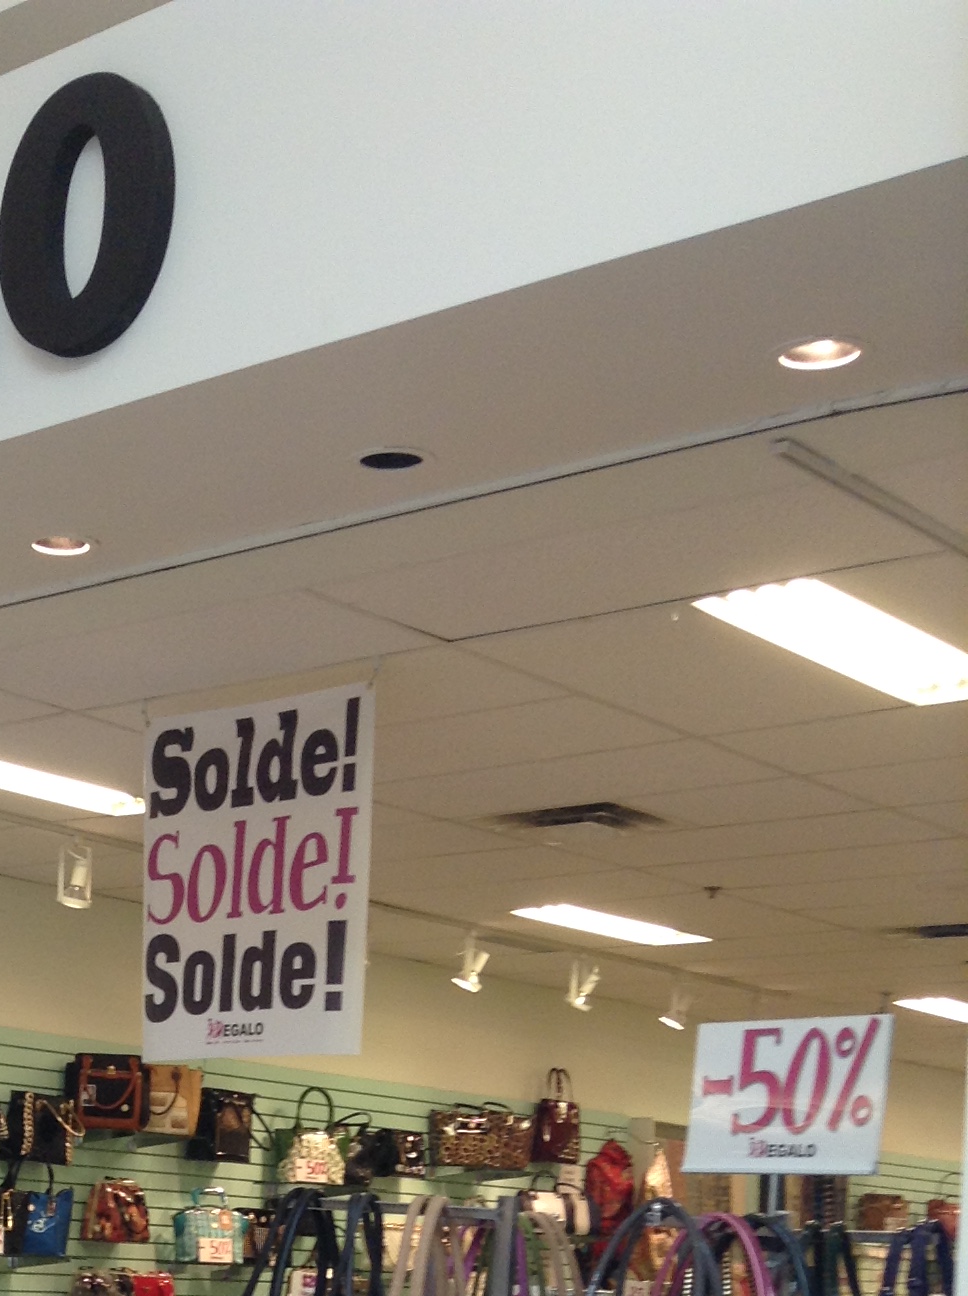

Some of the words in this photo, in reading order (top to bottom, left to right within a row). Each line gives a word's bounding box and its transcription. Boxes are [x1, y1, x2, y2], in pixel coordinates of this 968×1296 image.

[149, 696, 361, 819] Solde!
[147, 806, 359, 926] Solde!
[144, 919, 348, 1024] Solde!
